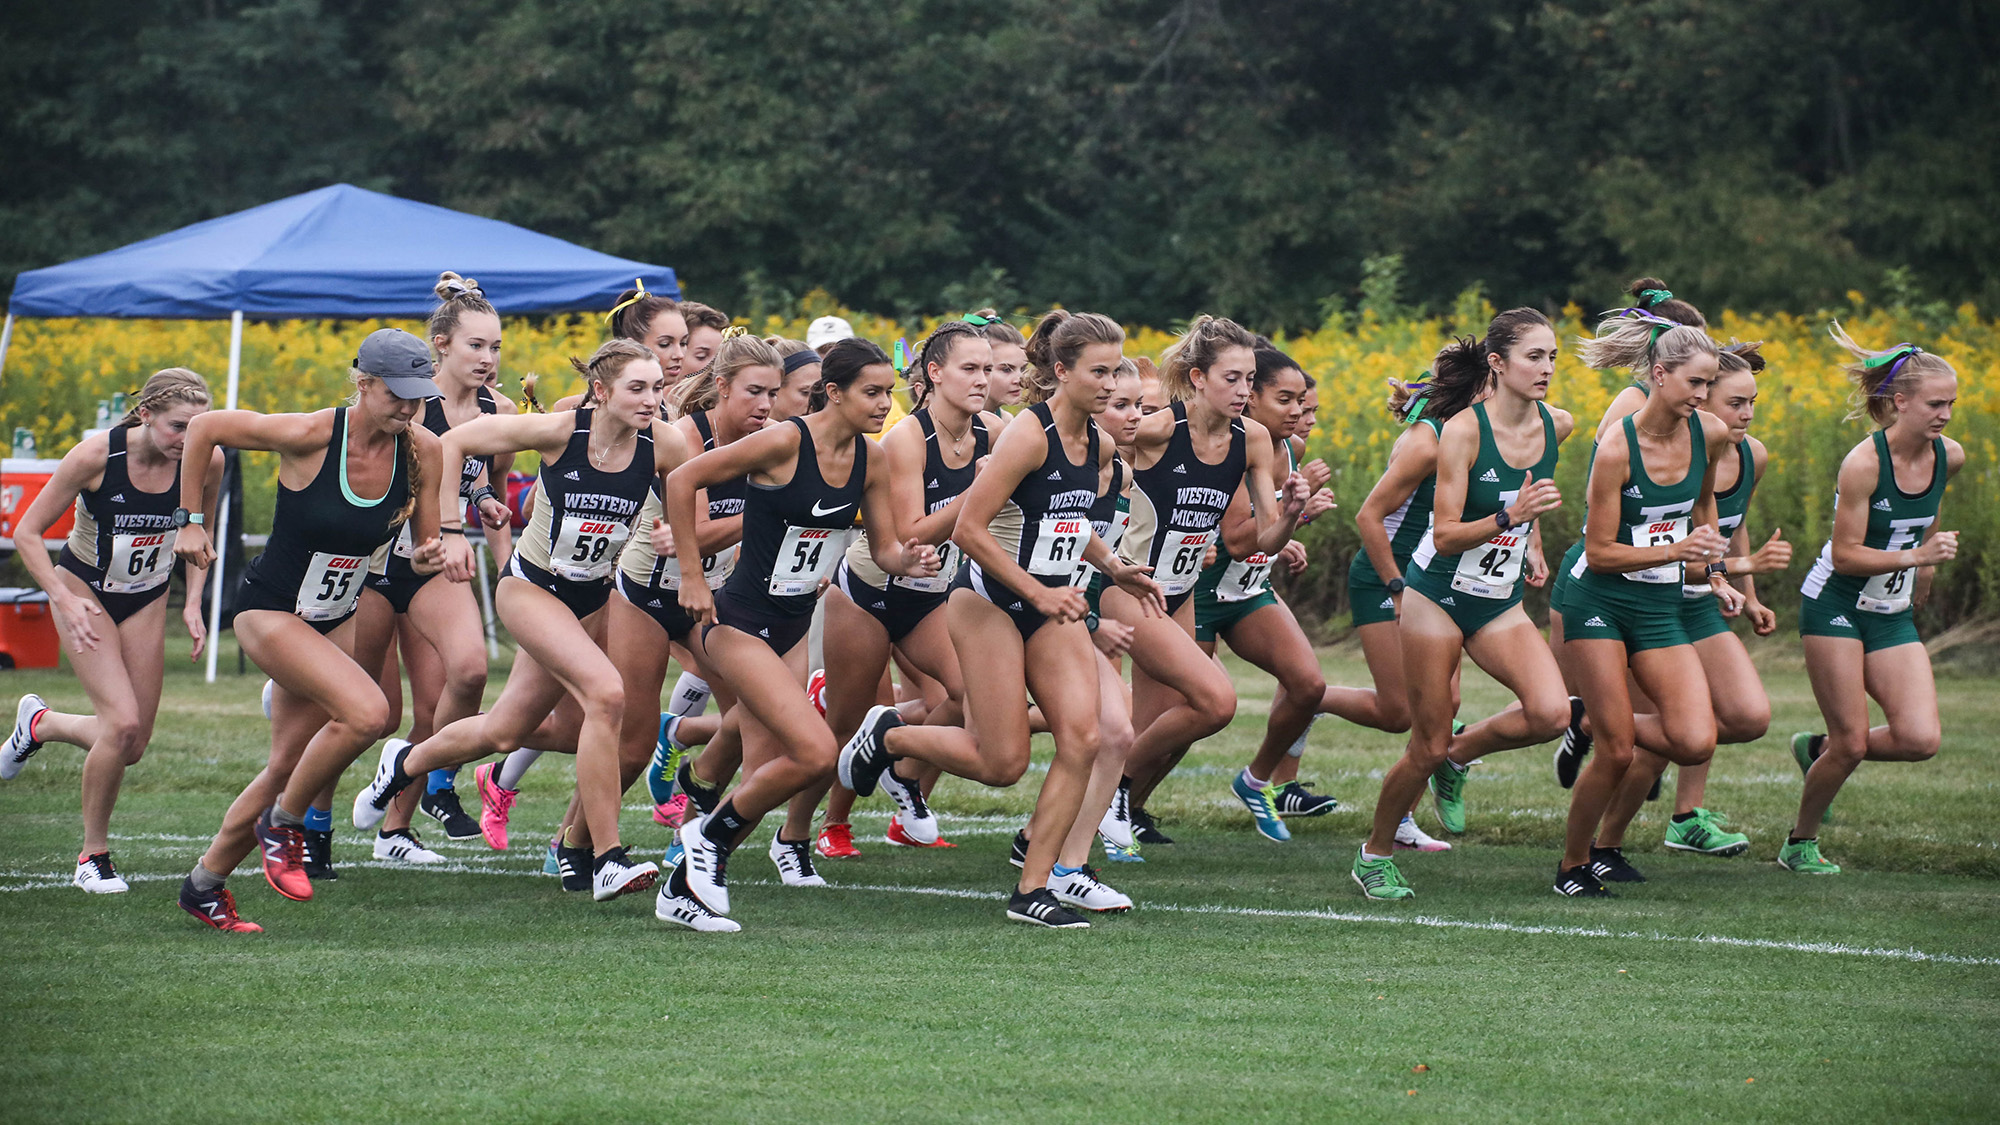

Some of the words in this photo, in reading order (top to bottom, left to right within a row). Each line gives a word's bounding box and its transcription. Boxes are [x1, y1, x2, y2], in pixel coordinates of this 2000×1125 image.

[564, 493, 638, 516] WESTERN
[708, 498, 746, 514] ESTER
[1048, 489, 1097, 511] WESTERN
[1176, 487, 1230, 510] WESTERN
[579, 522, 616, 534] GILL
[798, 529, 833, 539] GILL
[1054, 521, 1081, 534] GILL
[1648, 521, 1677, 534] GILL
[131, 534, 166, 548] GILL
[571, 535, 610, 563] 58
[1180, 534, 1209, 545] GILL
[1487, 535, 1519, 547] GILL
[128, 546, 161, 576] 64
[327, 557, 363, 570] GILL
[791, 541, 824, 573] 54
[1172, 546, 1203, 575] 65
[1479, 548, 1511, 578] 42
[316, 569, 354, 601] 55
[1238, 565, 1266, 593] 47
[1884, 568, 1909, 595] 45
